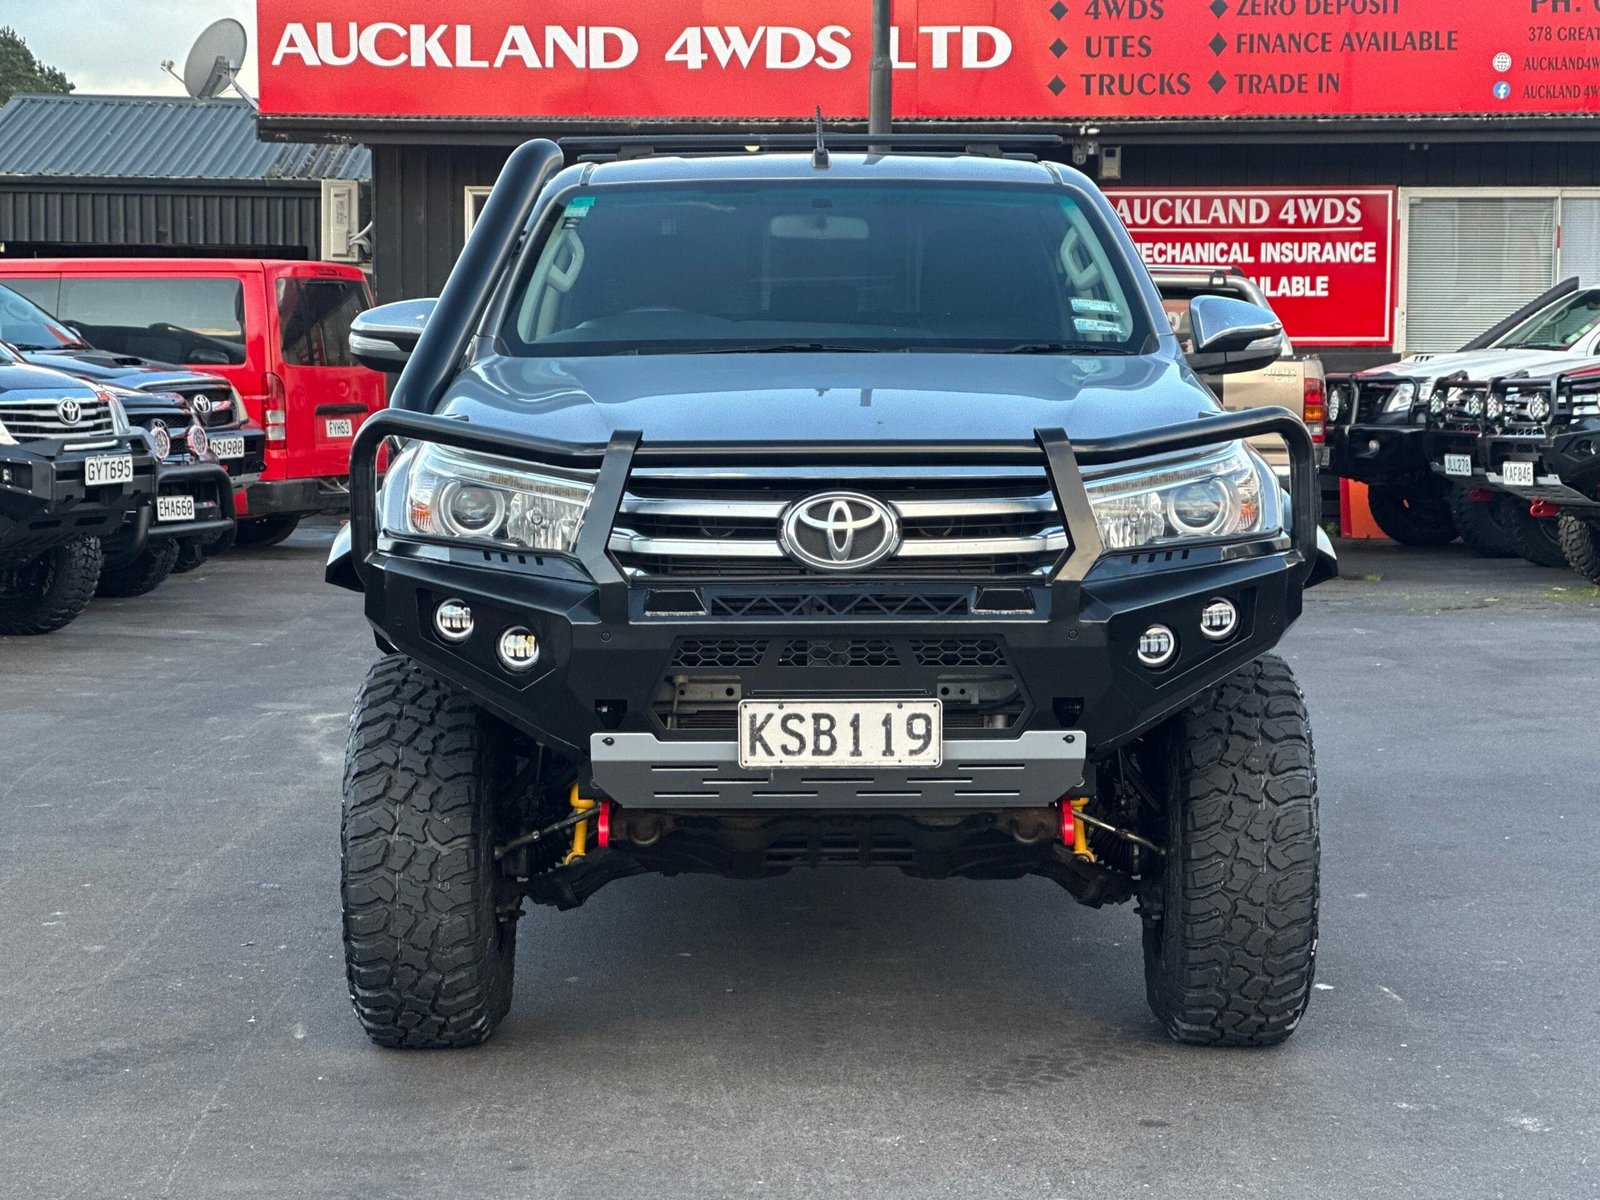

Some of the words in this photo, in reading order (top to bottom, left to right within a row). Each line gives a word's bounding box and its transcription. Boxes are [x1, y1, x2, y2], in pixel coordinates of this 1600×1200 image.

[1085, 0, 1164, 20] 4WDS
[1236, 0, 1296, 16] ZERO
[1305, 0, 1399, 15] DEPOSIT
[1236, 32, 1332, 54] FINANCE
[1340, 30, 1458, 52] AVAILABLE
[1528, 26, 1552, 41] 378
[271, 21, 638, 69] AUCKLAND
[665, 25, 852, 70] 4WDS
[889, 25, 1013, 69] LTD
[1085, 35, 1152, 58] UTES
[1080, 72, 1191, 96] TRUCKS
[1235, 73, 1308, 94] TRADE
[1317, 72, 1340, 93] IN
[1523, 84, 1581, 99] AUCKLAND
[1116, 198, 1269, 225] AUCKLAND
[1279, 197, 1361, 225] 4WDS
[1260, 242, 1376, 263] INSURANCE
[88, 458, 131, 482] GYT695
[159, 499, 193, 517] EHA660
[749, 712, 932, 757] KSB119
